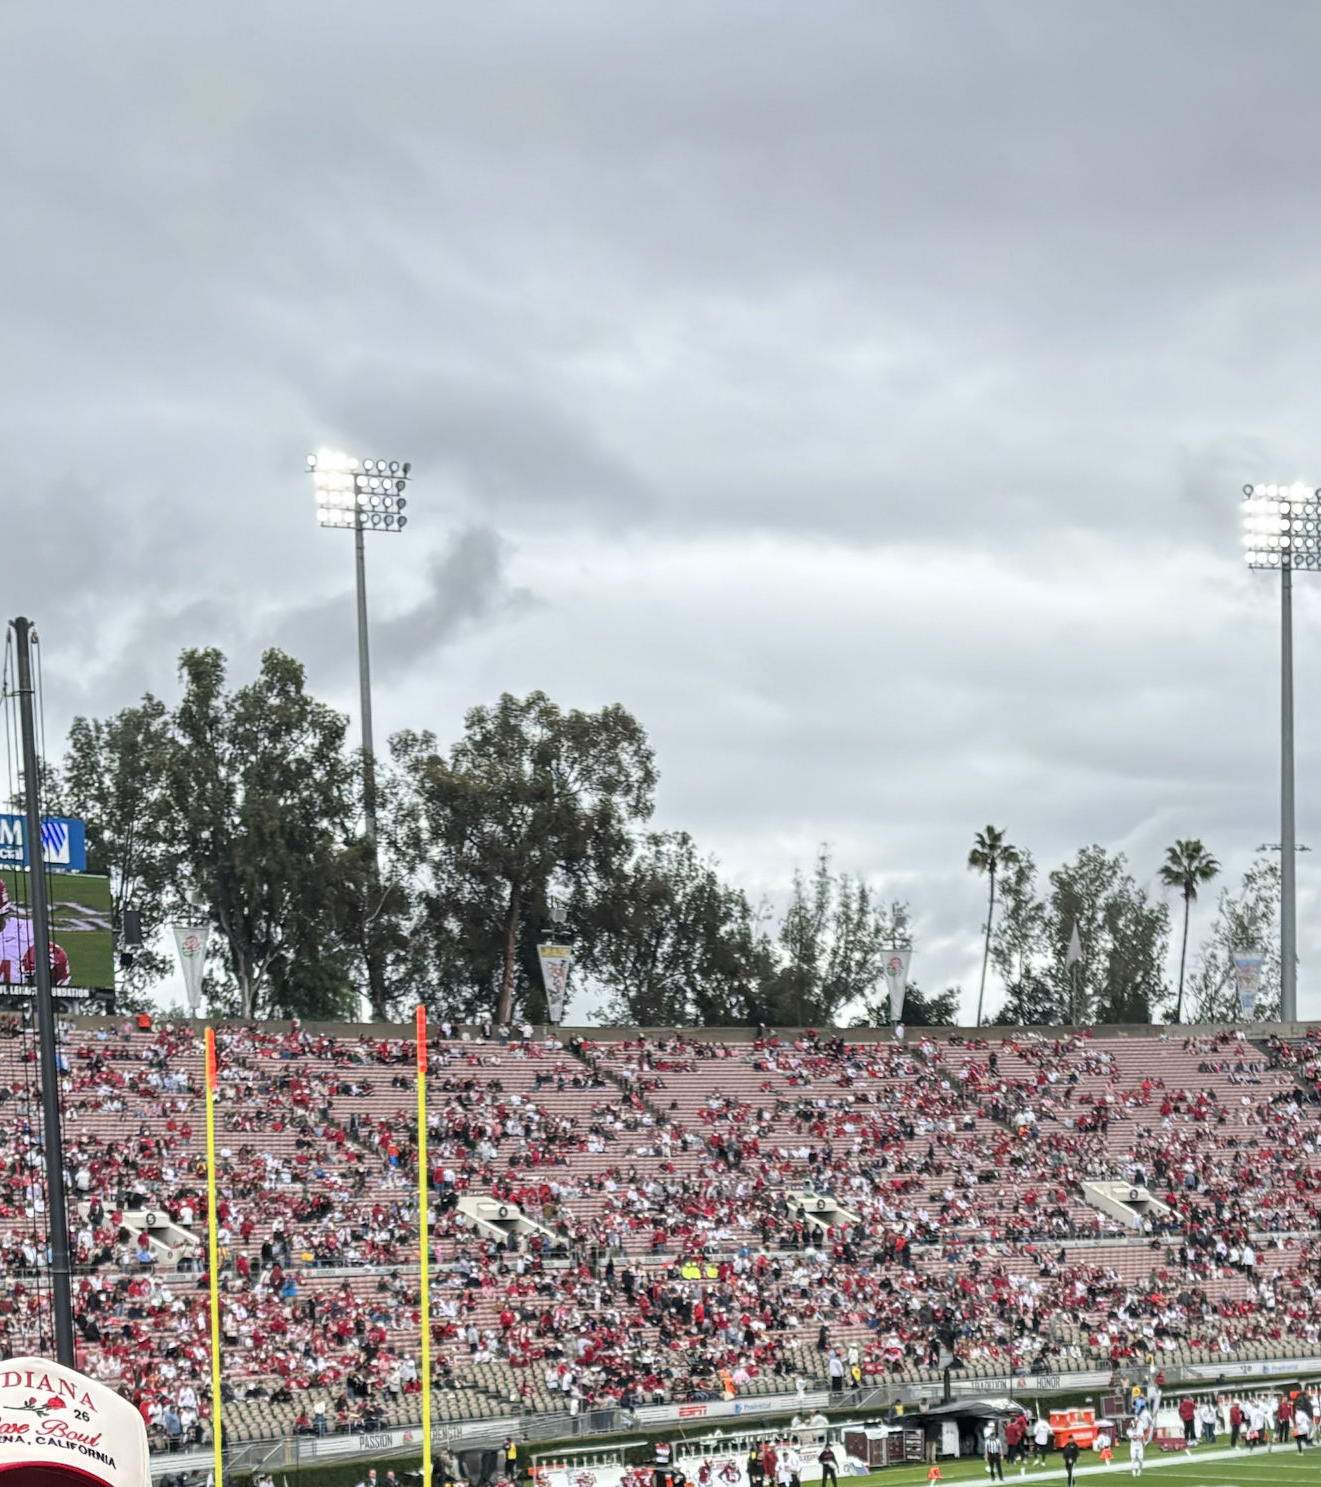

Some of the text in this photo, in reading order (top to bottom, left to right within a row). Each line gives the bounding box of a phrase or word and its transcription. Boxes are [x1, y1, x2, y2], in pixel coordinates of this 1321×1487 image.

[1037, 1376, 1061, 1388] HONOR
[73, 1409, 90, 1422] 26
[678, 1405, 707, 1417] ESPN
[35, 1418, 103, 1447] Bowl
[359, 1434, 393, 1449] PASSION
[35, 1436, 117, 1470] CALIFORNIA
